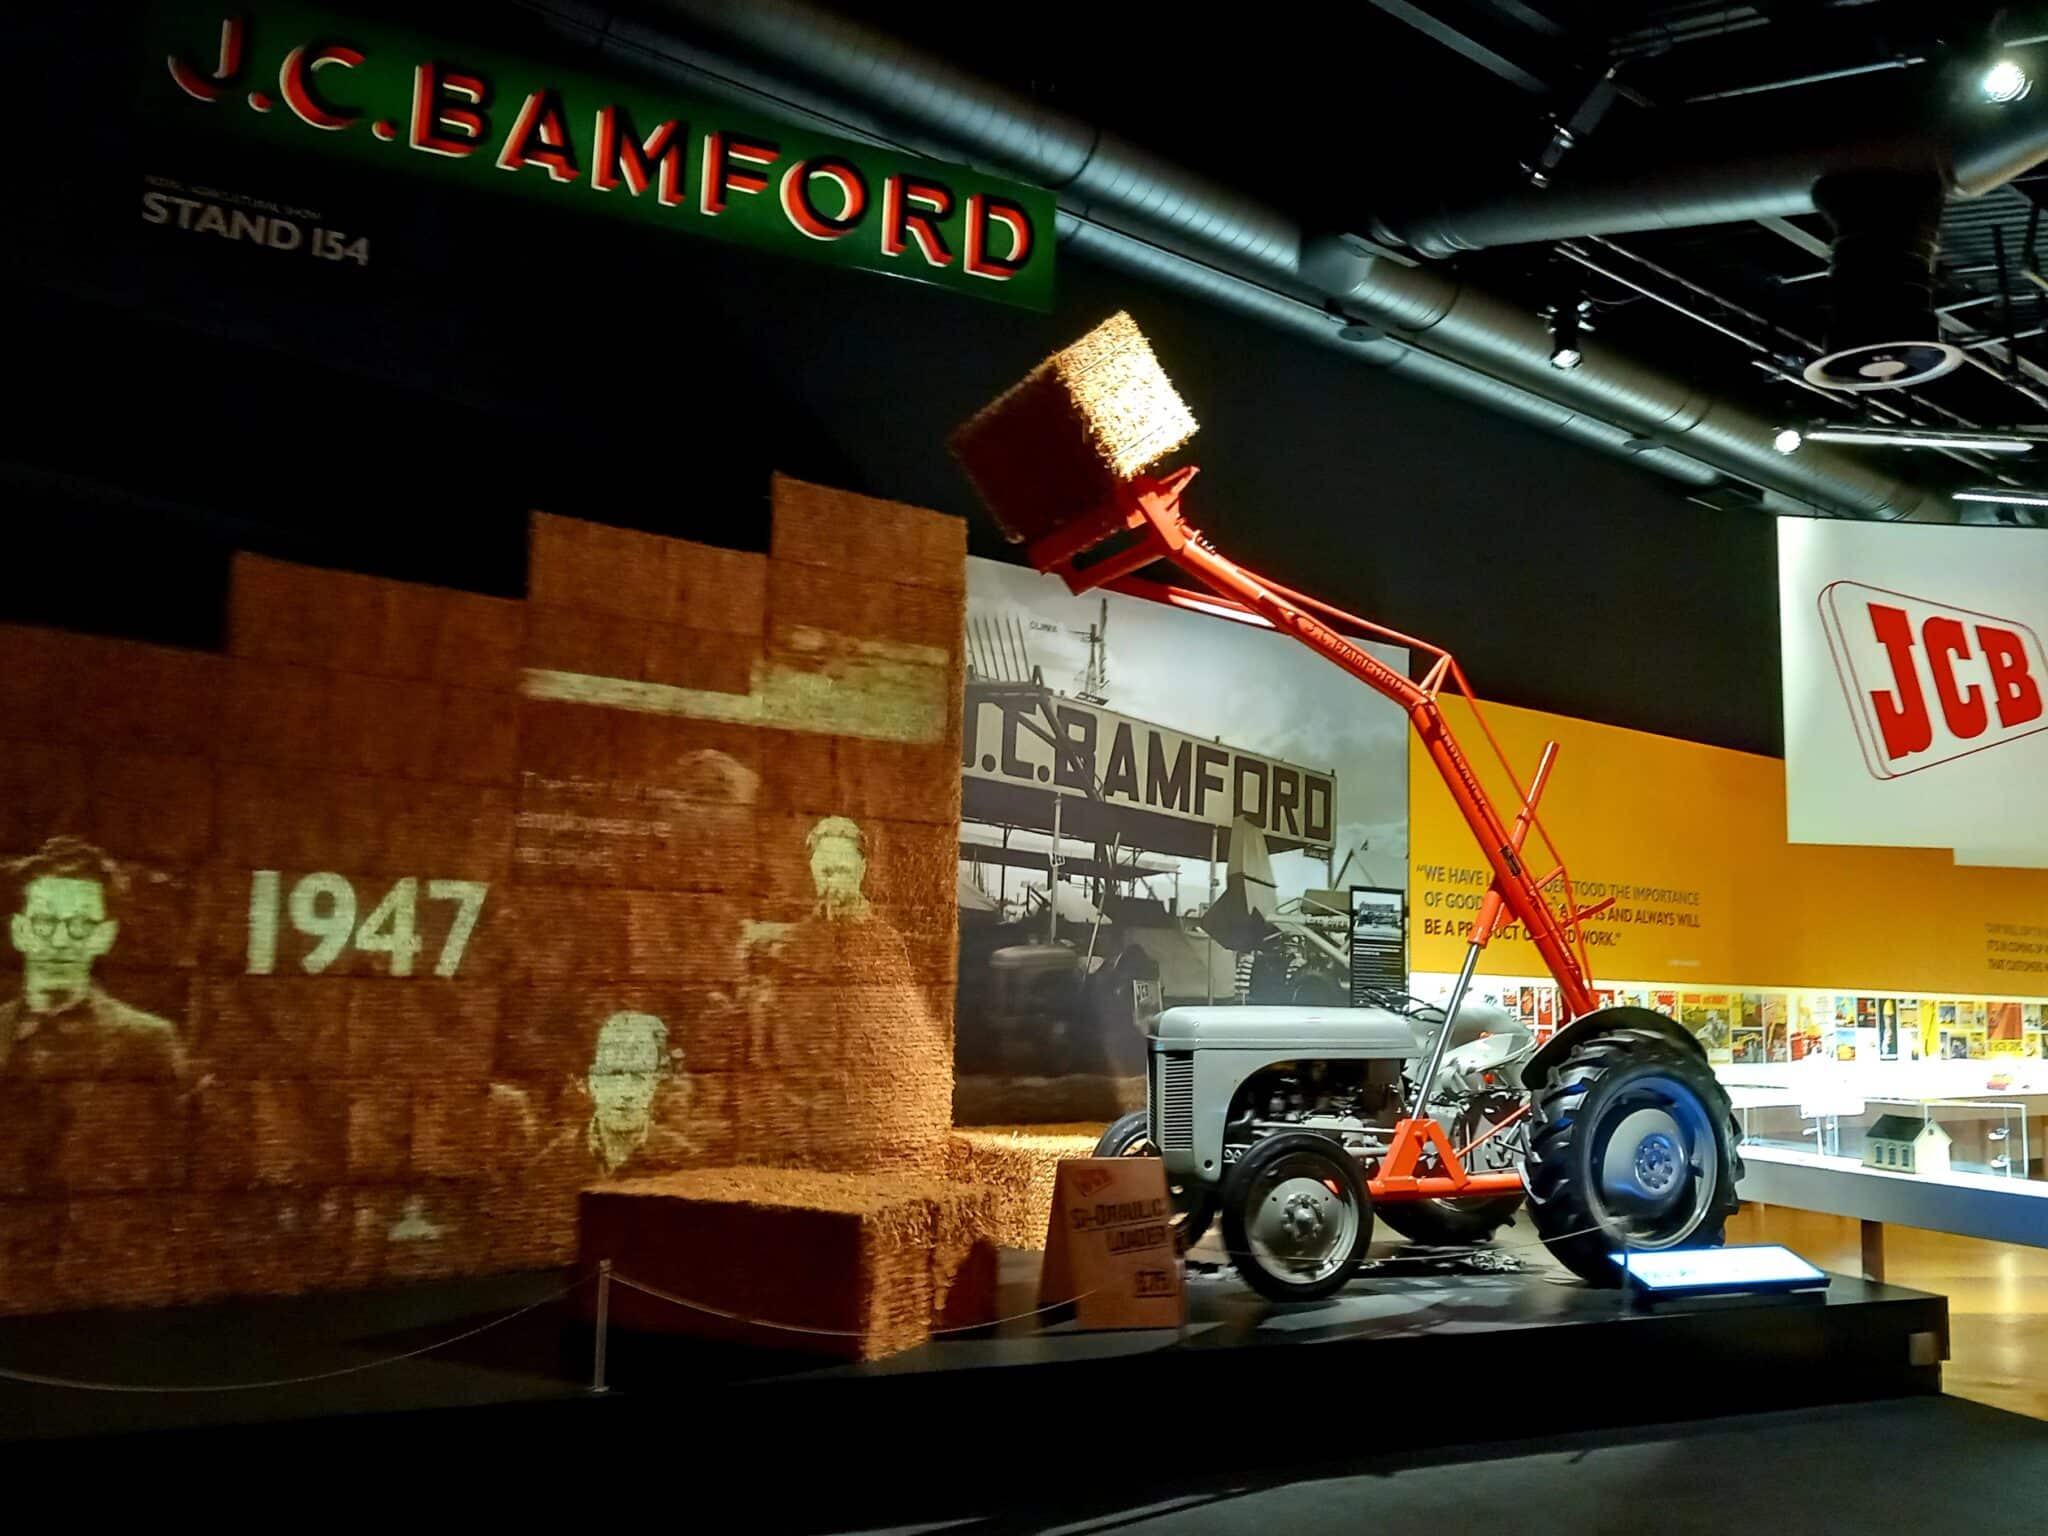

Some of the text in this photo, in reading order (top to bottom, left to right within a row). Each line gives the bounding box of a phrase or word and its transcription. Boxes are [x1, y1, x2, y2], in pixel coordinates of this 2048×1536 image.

[142, 190, 303, 251] STAND
[311, 226, 370, 267] 154
[1866, 602, 2043, 761] JCB
[1424, 891, 1442, 908] OF
[1607, 908, 1633, 922] AND
[1634, 911, 1676, 926] ALWAYS
[1678, 916, 1700, 928] WILL
[1449, 867, 1482, 887] HAVE
[1609, 884, 1632, 899] THE
[1633, 888, 1700, 906] IMPORTANCE
[246, 870, 490, 977] 1947
[1424, 918, 1442, 935] BE
[1444, 921, 1455, 936] A
